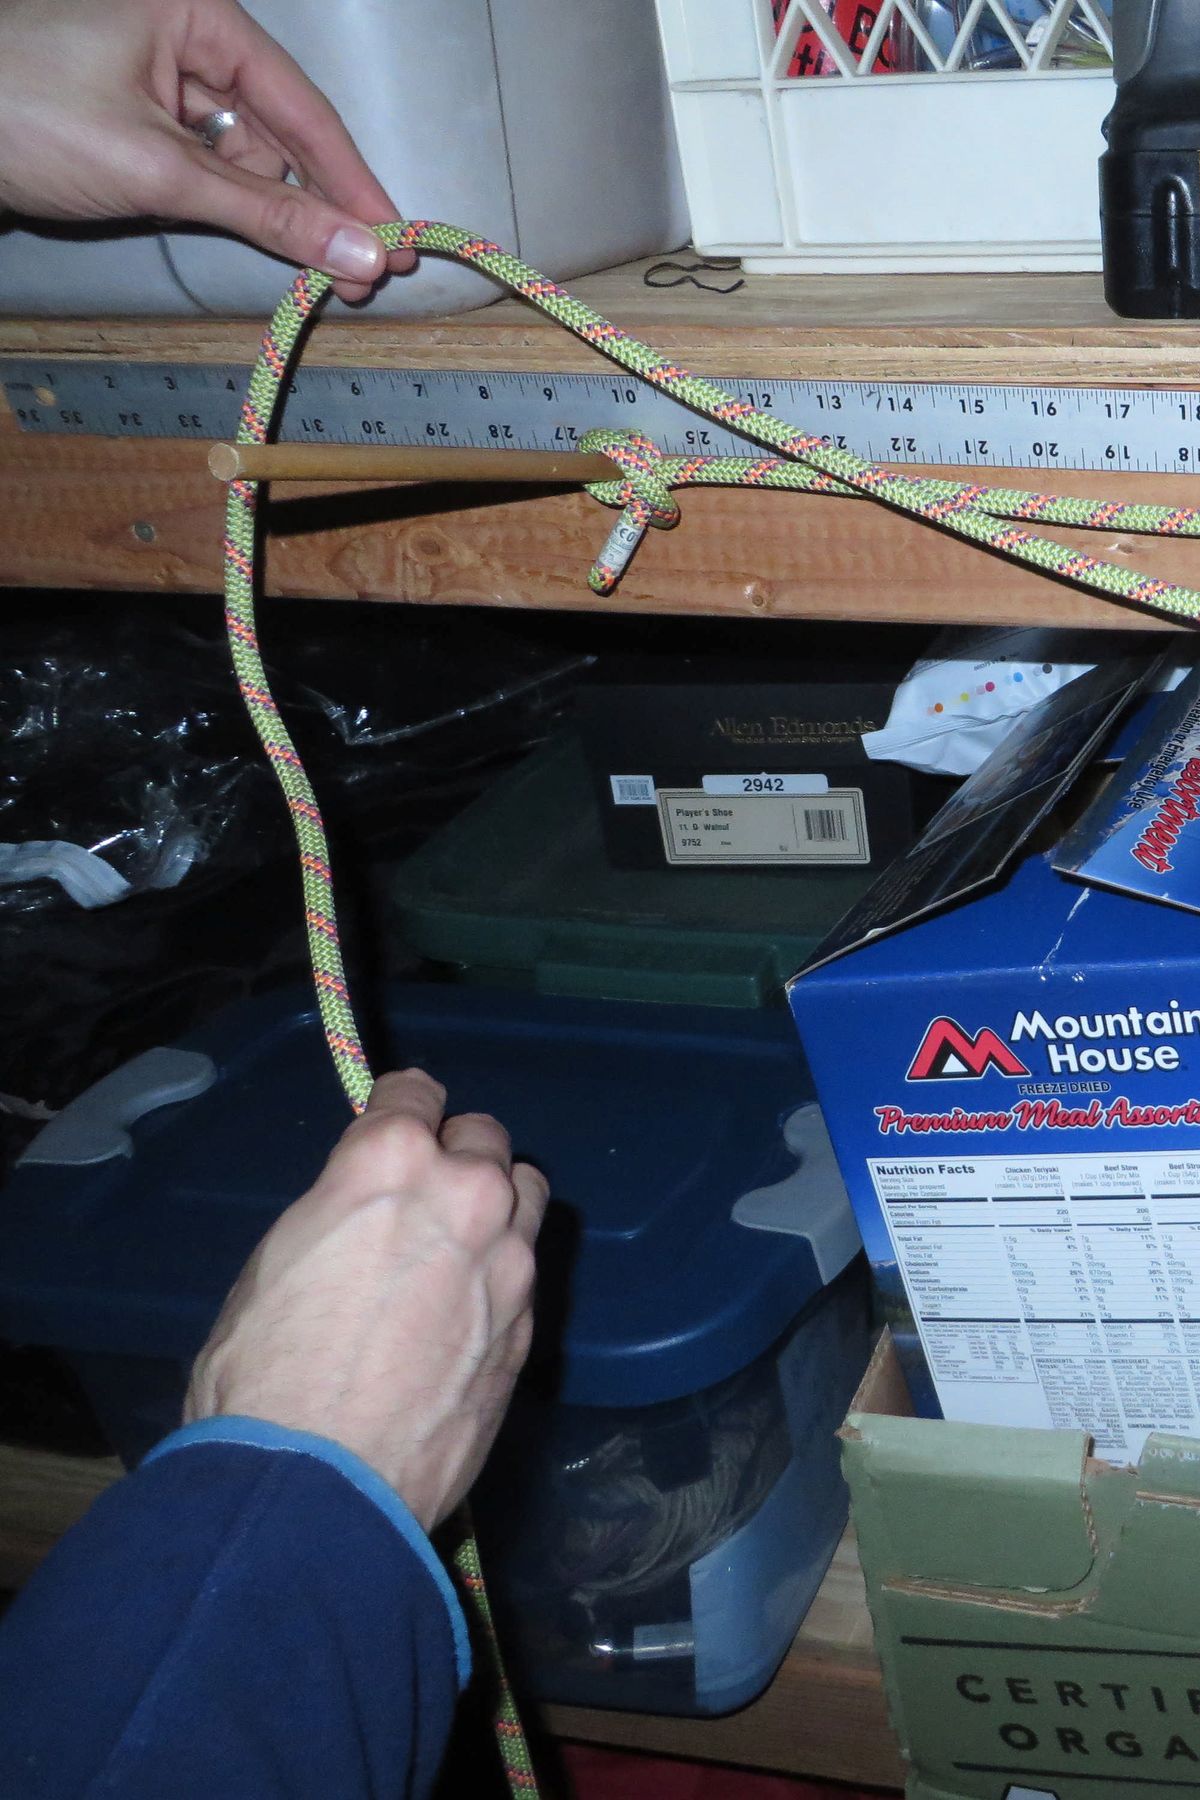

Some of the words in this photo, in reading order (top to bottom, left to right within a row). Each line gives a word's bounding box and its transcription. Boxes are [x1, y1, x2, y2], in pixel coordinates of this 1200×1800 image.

[46, 373, 54, 386] 1
[104, 375, 116, 388] 2
[164, 376, 176, 390] 3
[225, 379, 236, 391] 4
[350, 382, 361, 396] 6
[413, 384, 423, 397] 7
[478, 385, 490, 400] 8
[543, 387, 553, 401] 9
[611, 388, 637, 404] 10
[747, 393, 773, 408] 12
[816, 395, 842, 410] 13
[887, 397, 913, 412] 14
[959, 399, 985, 414] 15
[1031, 401, 1057, 416] 16
[1105, 403, 1130, 419] 17
[60, 410, 83, 424] 35
[118, 412, 143, 426] 34
[178, 414, 202, 428] 33
[301, 418, 324, 433] 31
[361, 419, 386, 435] 30
[425, 422, 450, 438] 29
[488, 424, 514, 439] 28
[554, 426, 578, 442] 27
[685, 430, 711, 445] 25
[890, 437, 917, 452] 22
[964, 440, 988, 455] 21
[1032, 442, 1059, 457] 20
[1104, 445, 1130, 460] 19
[1137, 742, 1185, 790] Emergency
[742, 778, 785, 792] 2942
[1126, 787, 1155, 809] Use
[676, 808, 710, 818] Player's
[711, 808, 734, 817] Shoe
[681, 838, 701, 847] 9752
[1047, 1043, 1181, 1074] House
[1018, 1081, 1069, 1096] FREEZE
[1069, 1081, 1111, 1094] DRIED
[874, 1104, 1014, 1135] Premium
[1013, 1098, 1102, 1131] Meal
[876, 1165, 935, 1176] Nutrition
[938, 1164, 976, 1175] Facts
[1005, 1166, 1032, 1174] Chicken
[1168, 1162, 1185, 1170] Beef
